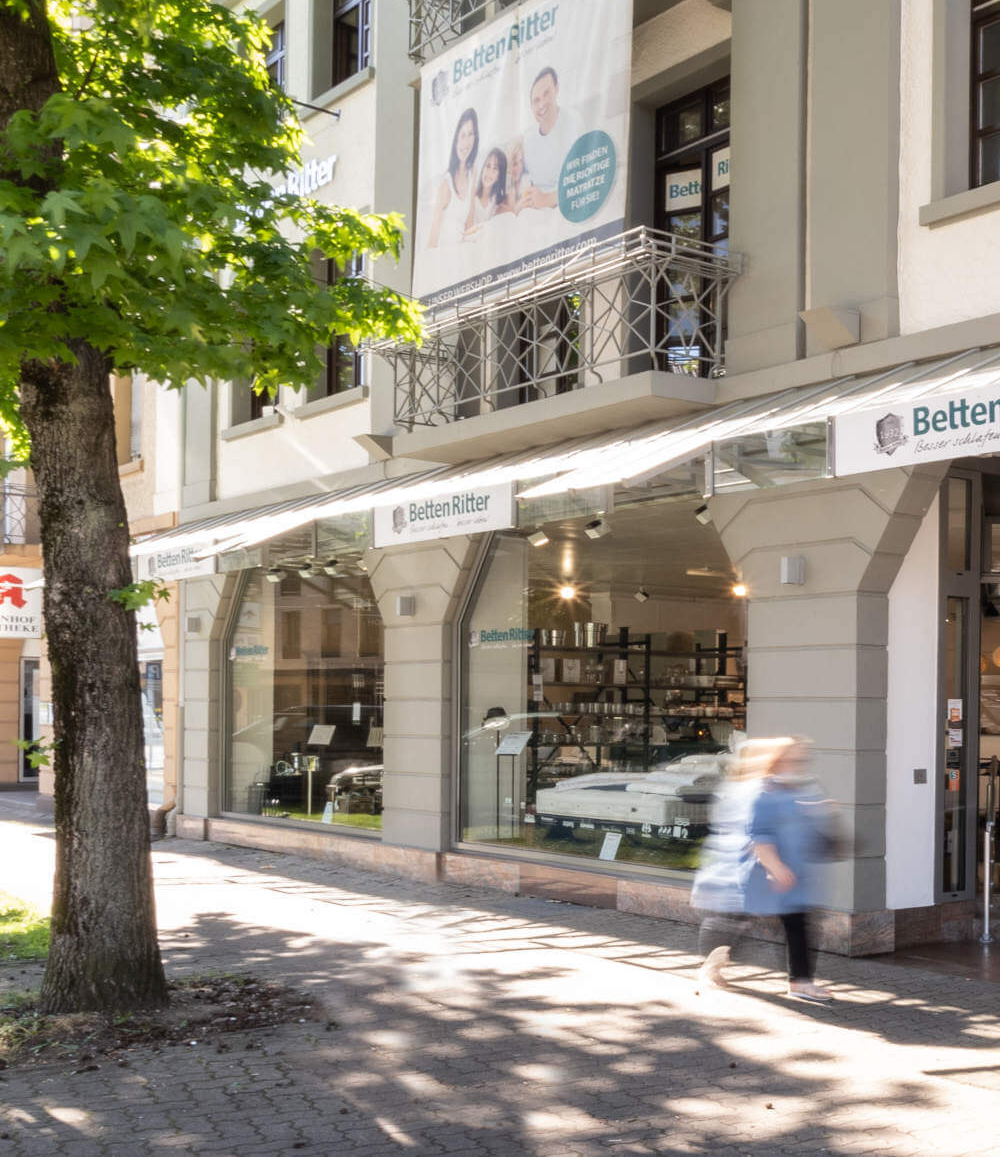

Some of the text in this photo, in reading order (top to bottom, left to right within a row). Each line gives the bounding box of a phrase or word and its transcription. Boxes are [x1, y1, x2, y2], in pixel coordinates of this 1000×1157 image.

[453, 37, 506, 84] Betten
[507, 4, 559, 52] Ritter
[669, 180, 703, 199] Bett
[914, 438, 950, 455] Besser
[408, 492, 490, 523] Betten Ritter
